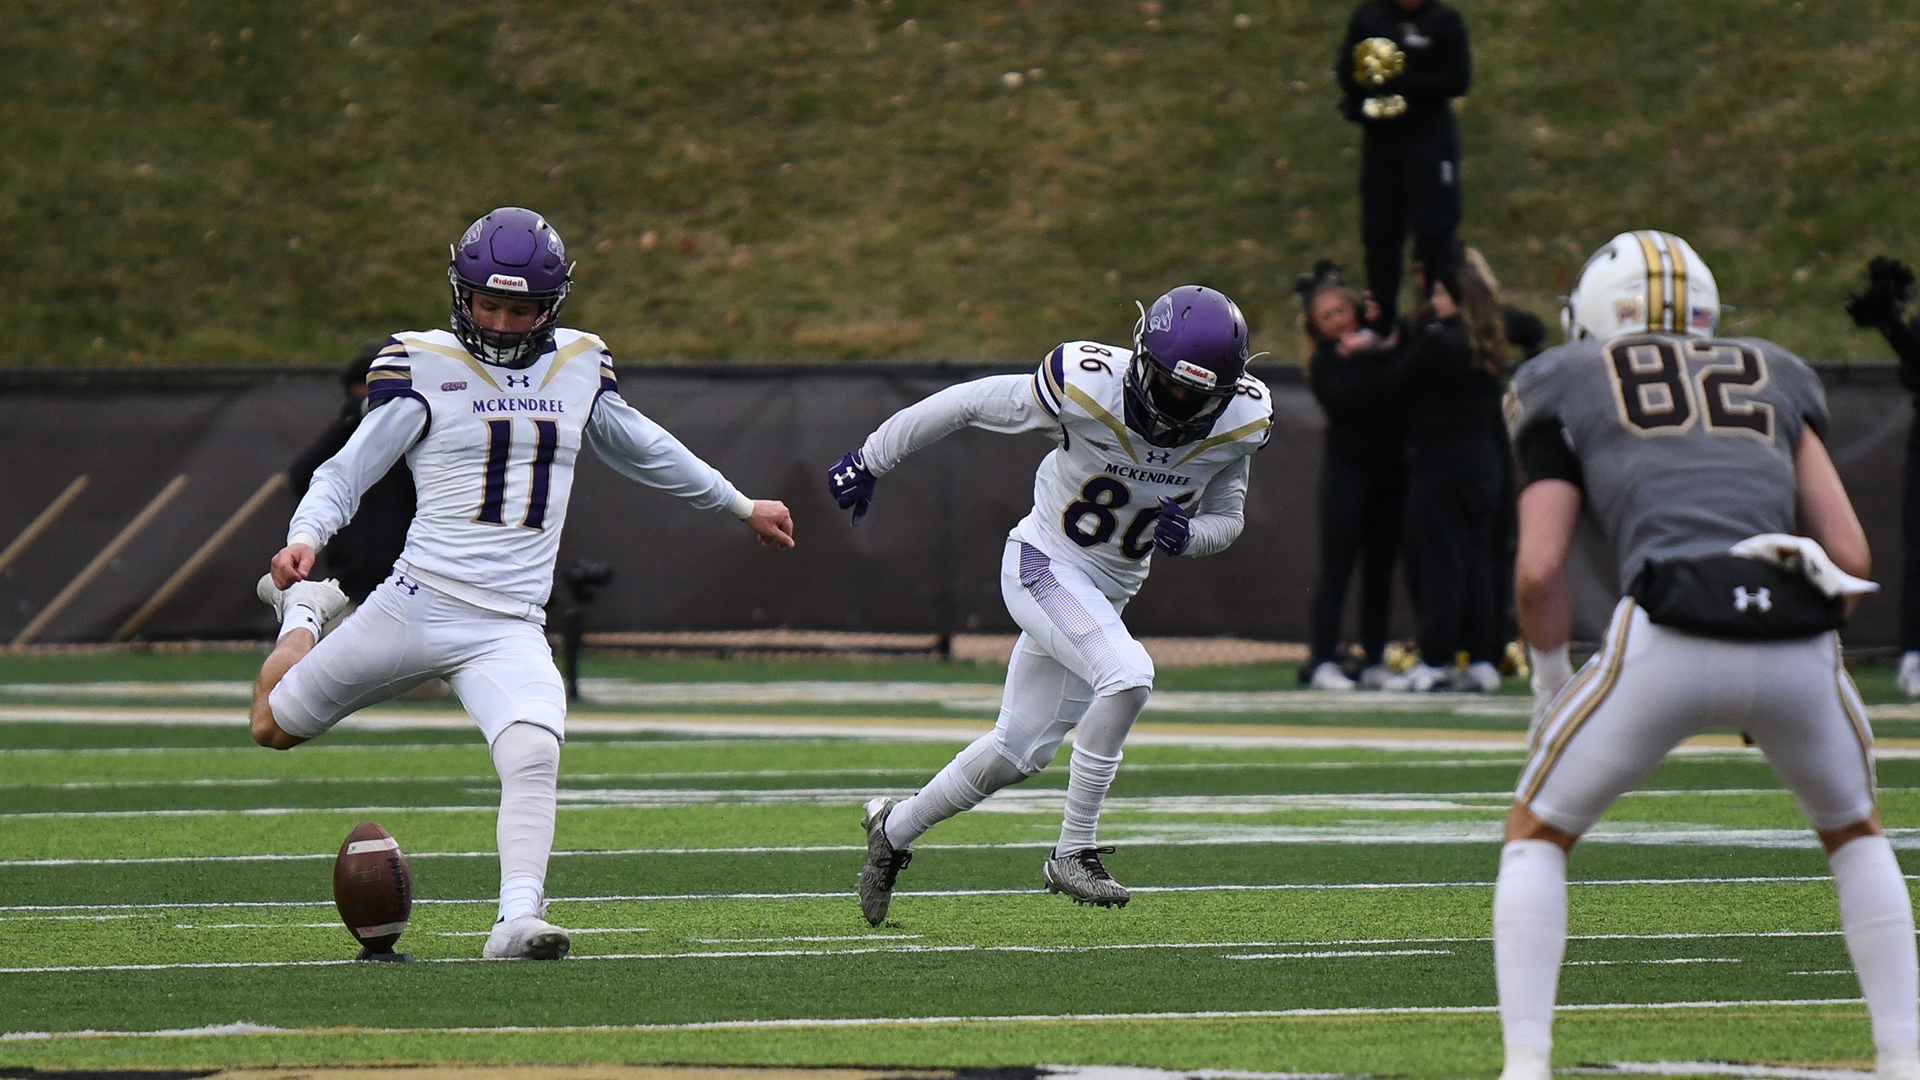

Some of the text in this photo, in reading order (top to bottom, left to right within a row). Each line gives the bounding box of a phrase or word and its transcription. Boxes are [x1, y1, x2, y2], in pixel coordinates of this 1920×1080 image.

[492, 276, 523, 287] Riddell
[1603, 332, 1776, 446] 82
[472, 398, 565, 413] MCKENDREE
[470, 416, 560, 532] 11
[1104, 462, 1192, 486] MCKENDREE
